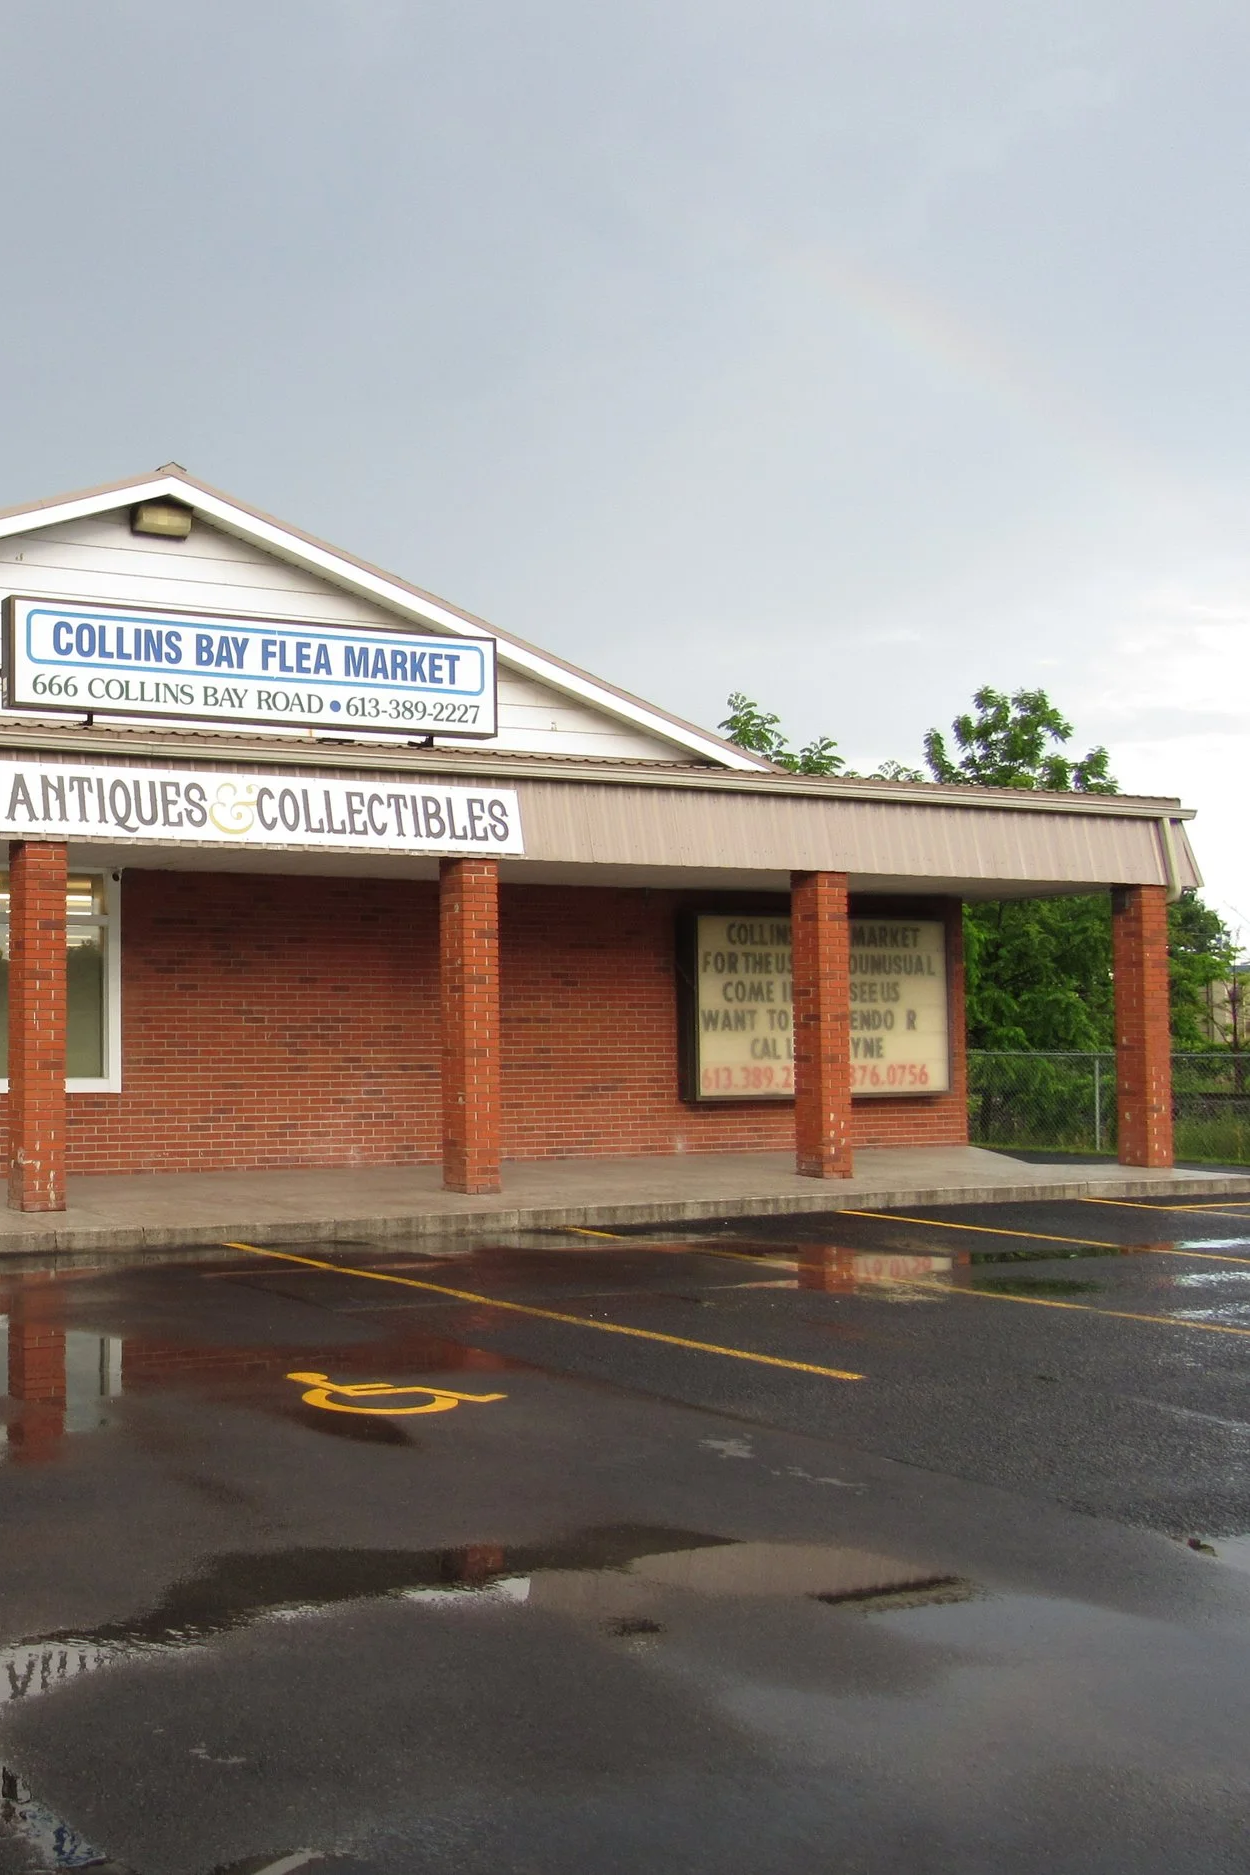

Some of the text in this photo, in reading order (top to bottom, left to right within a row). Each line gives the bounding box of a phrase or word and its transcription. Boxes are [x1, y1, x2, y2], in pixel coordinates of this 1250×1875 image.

[53, 621, 460, 685] COLLINS BAY FLEA MARKET
[32, 673, 480, 724] 666 COLLINS BAY ROAD 613-389-2227
[5, 773, 509, 842] ANTIQUES & COLLECTIBLES
[851, 926, 920, 949] MARKET
[722, 980, 774, 1003] COME
[701, 1009, 757, 1032] WANT
[767, 1009, 789, 1031] TO
